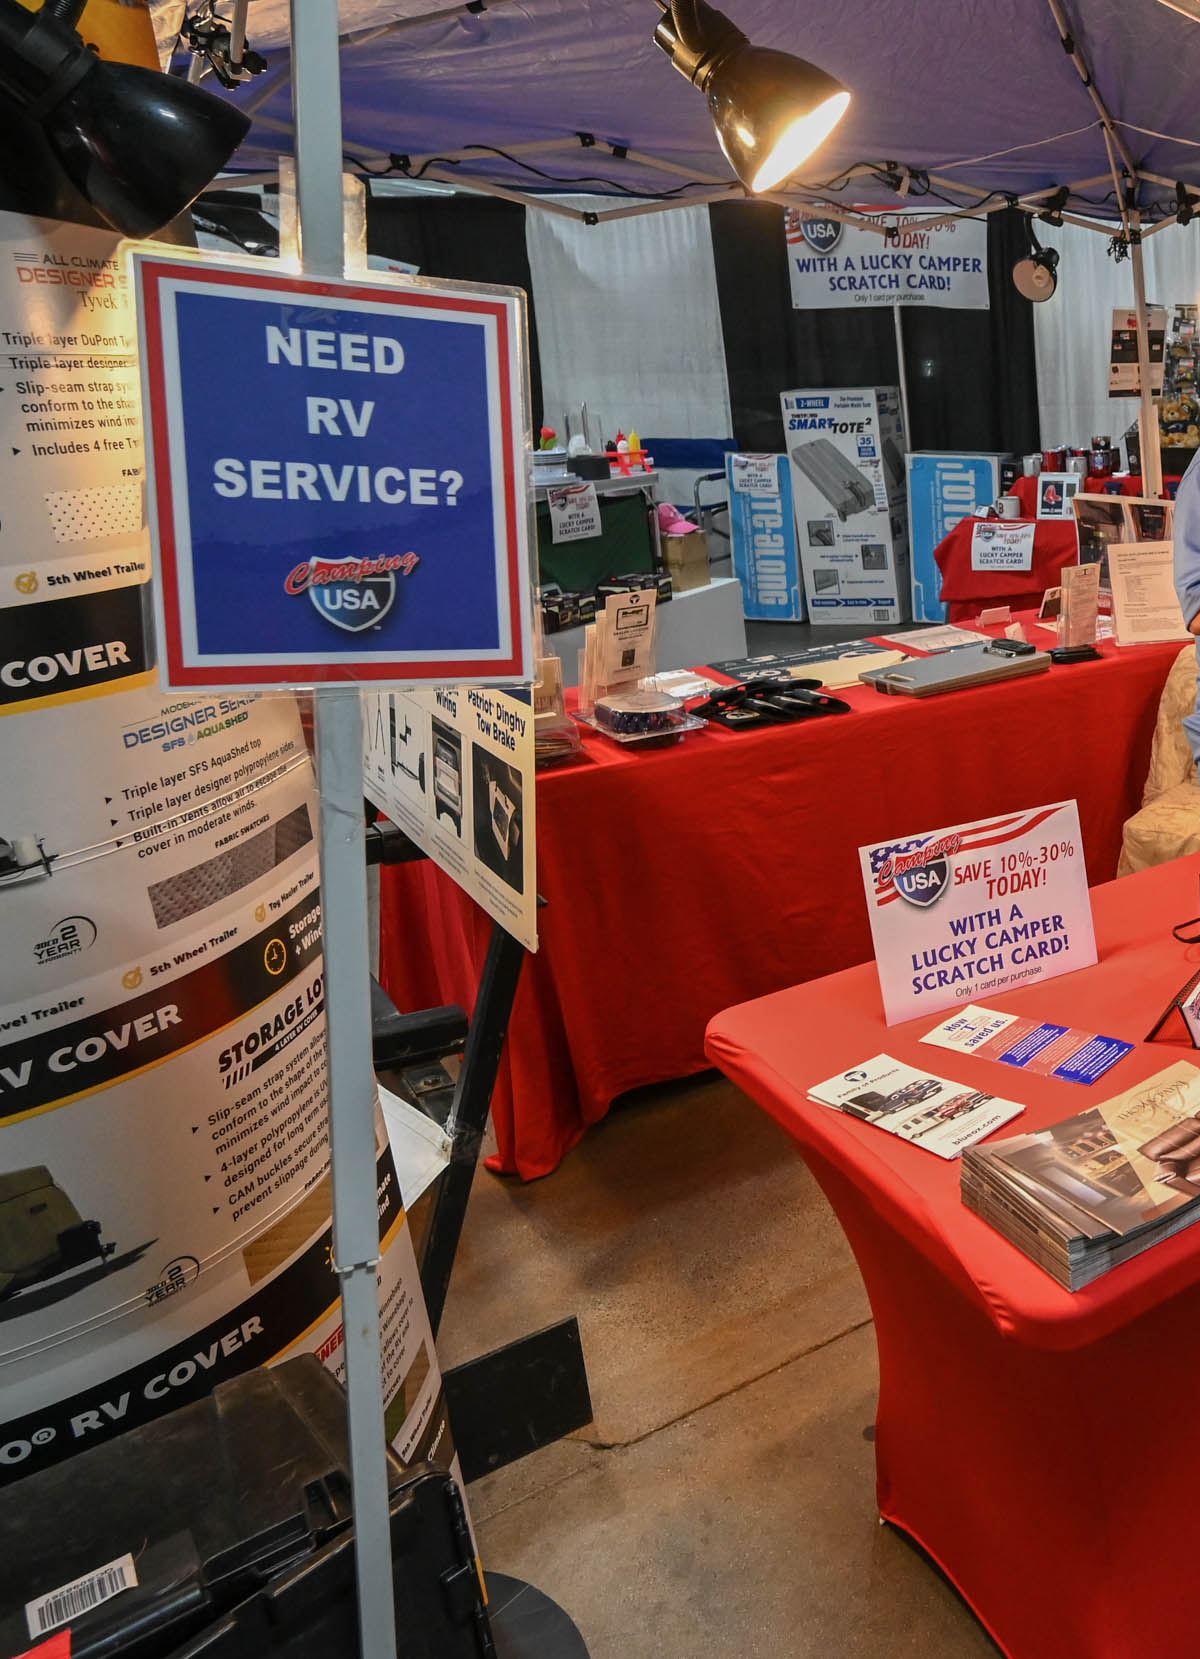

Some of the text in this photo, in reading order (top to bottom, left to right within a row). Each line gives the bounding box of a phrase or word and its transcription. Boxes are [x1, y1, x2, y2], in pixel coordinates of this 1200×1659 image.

[807, 223, 836, 239] USA
[16, 266, 116, 289] DESIGNER
[43, 253, 120, 271] ALL CLIMATE
[796, 254, 983, 273] WITH A LUCKY CAMPER
[829, 274, 951, 292] SCRATCH CARD!
[77, 290, 119, 313] Tyvek
[2, 332, 45, 348] Triple
[49, 335, 78, 349] layer
[80, 334, 118, 347] DuPont
[265, 325, 406, 375] NEED
[8, 356, 128, 374] Triple layer designer
[15, 380, 85, 397] Slip-seam
[88, 381, 114, 395] strap
[21, 399, 80, 414] conform
[82, 400, 94, 411] to
[98, 398, 114, 410] the
[26, 417, 96, 433] minimizes
[98, 416, 123, 428] wind
[306, 396, 376, 438] RV
[788, 418, 836, 431] SMART
[32, 441, 91, 457] Includes
[93, 440, 101, 452] 4
[103, 439, 125, 451] free
[860, 437, 872, 445] 35
[212, 457, 465, 506] SERVICE?
[46, 566, 112, 587] 5th Wheel
[283, 550, 420, 596] Camping
[323, 589, 381, 611] USA
[0, 640, 131, 688] COVER
[435, 691, 457, 719] Wiring
[496, 701, 527, 738] Dinghy
[123, 706, 218, 749] DESIGNER
[162, 711, 250, 753] SFS AQUASHED
[476, 712, 517, 752] Tow Brake
[122, 736, 262, 802] Triple layer SFS AquaShed top
[128, 739, 295, 822] Triple layer designer polypropylene sides
[137, 812, 232, 858] cover in moderate
[214, 813, 270, 849] FABRIC SWATCHES
[877, 832, 963, 888] Camping
[954, 840, 1074, 886] SAVE 10%-30%
[903, 870, 942, 893] USA
[986, 868, 1047, 900] TODAY!
[60, 925, 78, 942] 2
[289, 904, 321, 940] Storage
[949, 903, 1024, 937] WITH A
[33, 939, 81, 960] YEAR
[149, 926, 239, 977] 5th Wheel Trailer
[911, 914, 1065, 972] LUCKY CAMPER
[911, 935, 1070, 995] SCRATCH CARD!
[955, 986, 973, 998] Only
[974, 984, 978, 993] 1
[980, 978, 996, 991] card
[997, 975, 1009, 988] per
[31, 996, 85, 1021] Trailer
[944, 1017, 968, 1032] How
[48, 1003, 183, 1073] COVER
[218, 995, 304, 1073] STORAGE
[964, 1026, 993, 1047] saved
[993, 1018, 1008, 1029] us.
[207, 1086, 262, 1127] Slip-seam
[263, 1068, 285, 1090] strap
[285, 1046, 310, 1073] system
[211, 1107, 257, 1141] conform
[258, 1098, 269, 1111] to
[270, 1086, 284, 1101] the
[285, 1067, 306, 1090] shape
[306, 1057, 314, 1070] of
[837, 1084, 861, 1099] Family
[869, 1067, 900, 1084] Products
[215, 1073, 314, 1156] minimizes wind impact
[952, 1114, 1001, 1146] blueox.com
[220, 1096, 314, 1173] 4-layer polypropylene
[223, 1105, 320, 1188] designed for long term
[228, 1182, 256, 1207] CAM
[257, 1153, 293, 1187] buckles
[293, 1128, 318, 1157] secure
[231, 1185, 273, 1223] prevent
[274, 1155, 309, 1190] slippage
[309, 1133, 329, 1158] during
[143, 1276, 187, 1303] YEAR
[70, 1391, 131, 1438] RV
[143, 1315, 265, 1401] COVER
